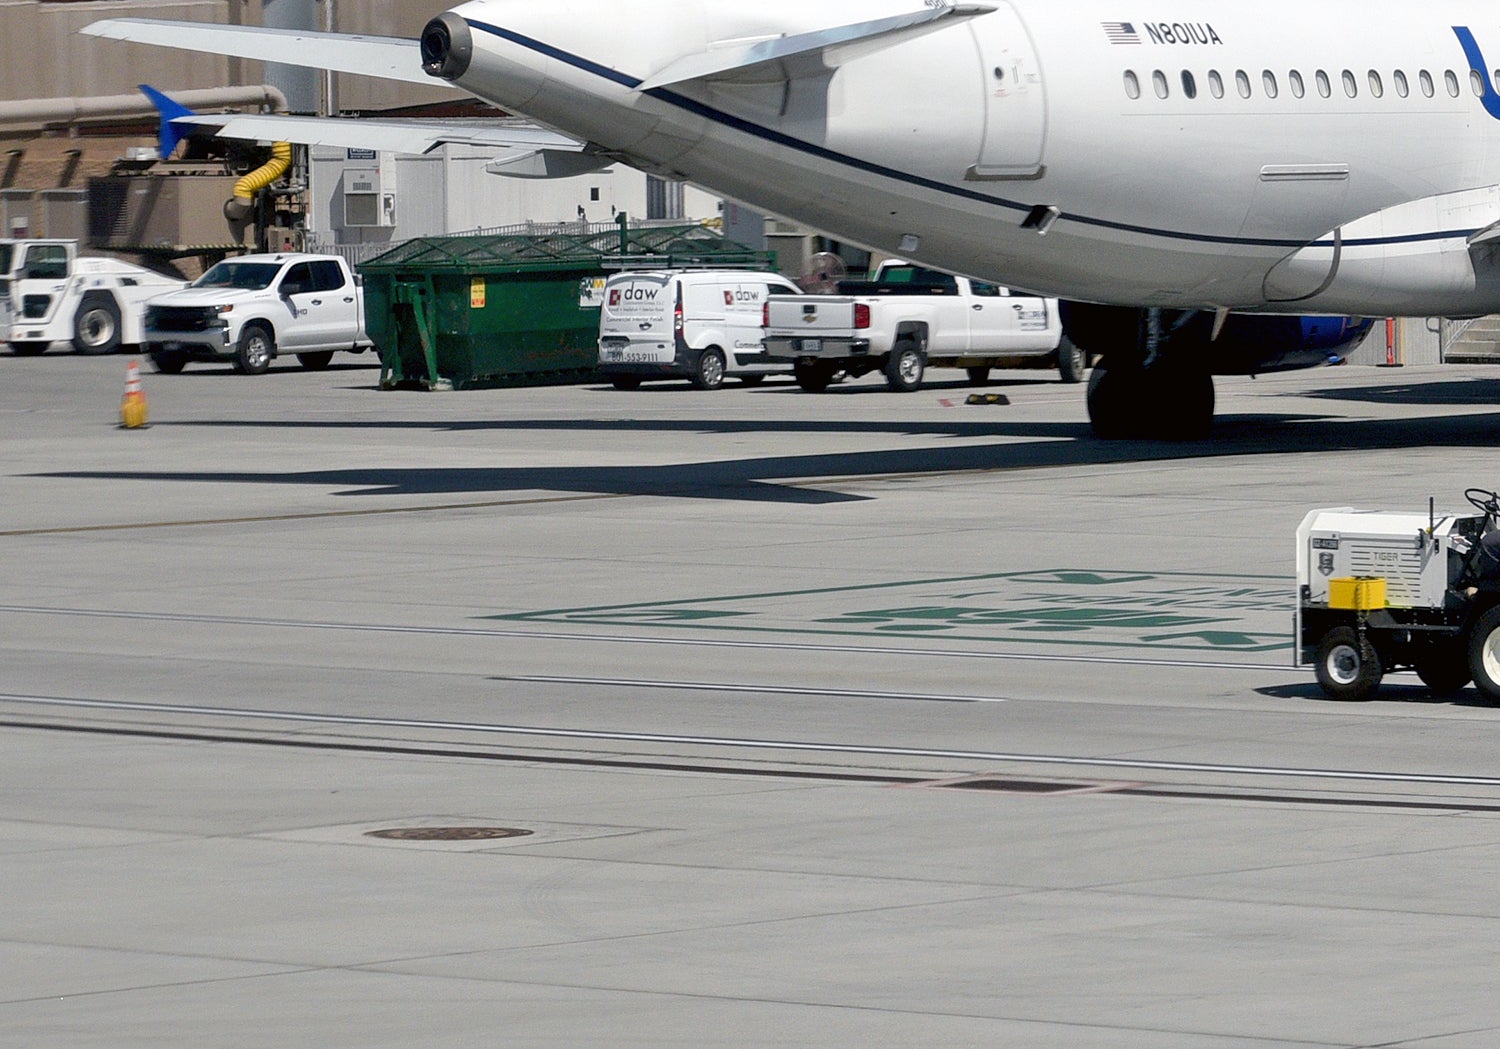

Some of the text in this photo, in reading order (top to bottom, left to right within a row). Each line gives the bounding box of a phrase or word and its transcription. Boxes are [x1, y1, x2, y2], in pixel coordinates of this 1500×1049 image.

[1143, 22, 1223, 45] N801UA
[624, 281, 659, 301] daw
[735, 283, 760, 301] daw
[1373, 552, 1398, 561] TIGER
